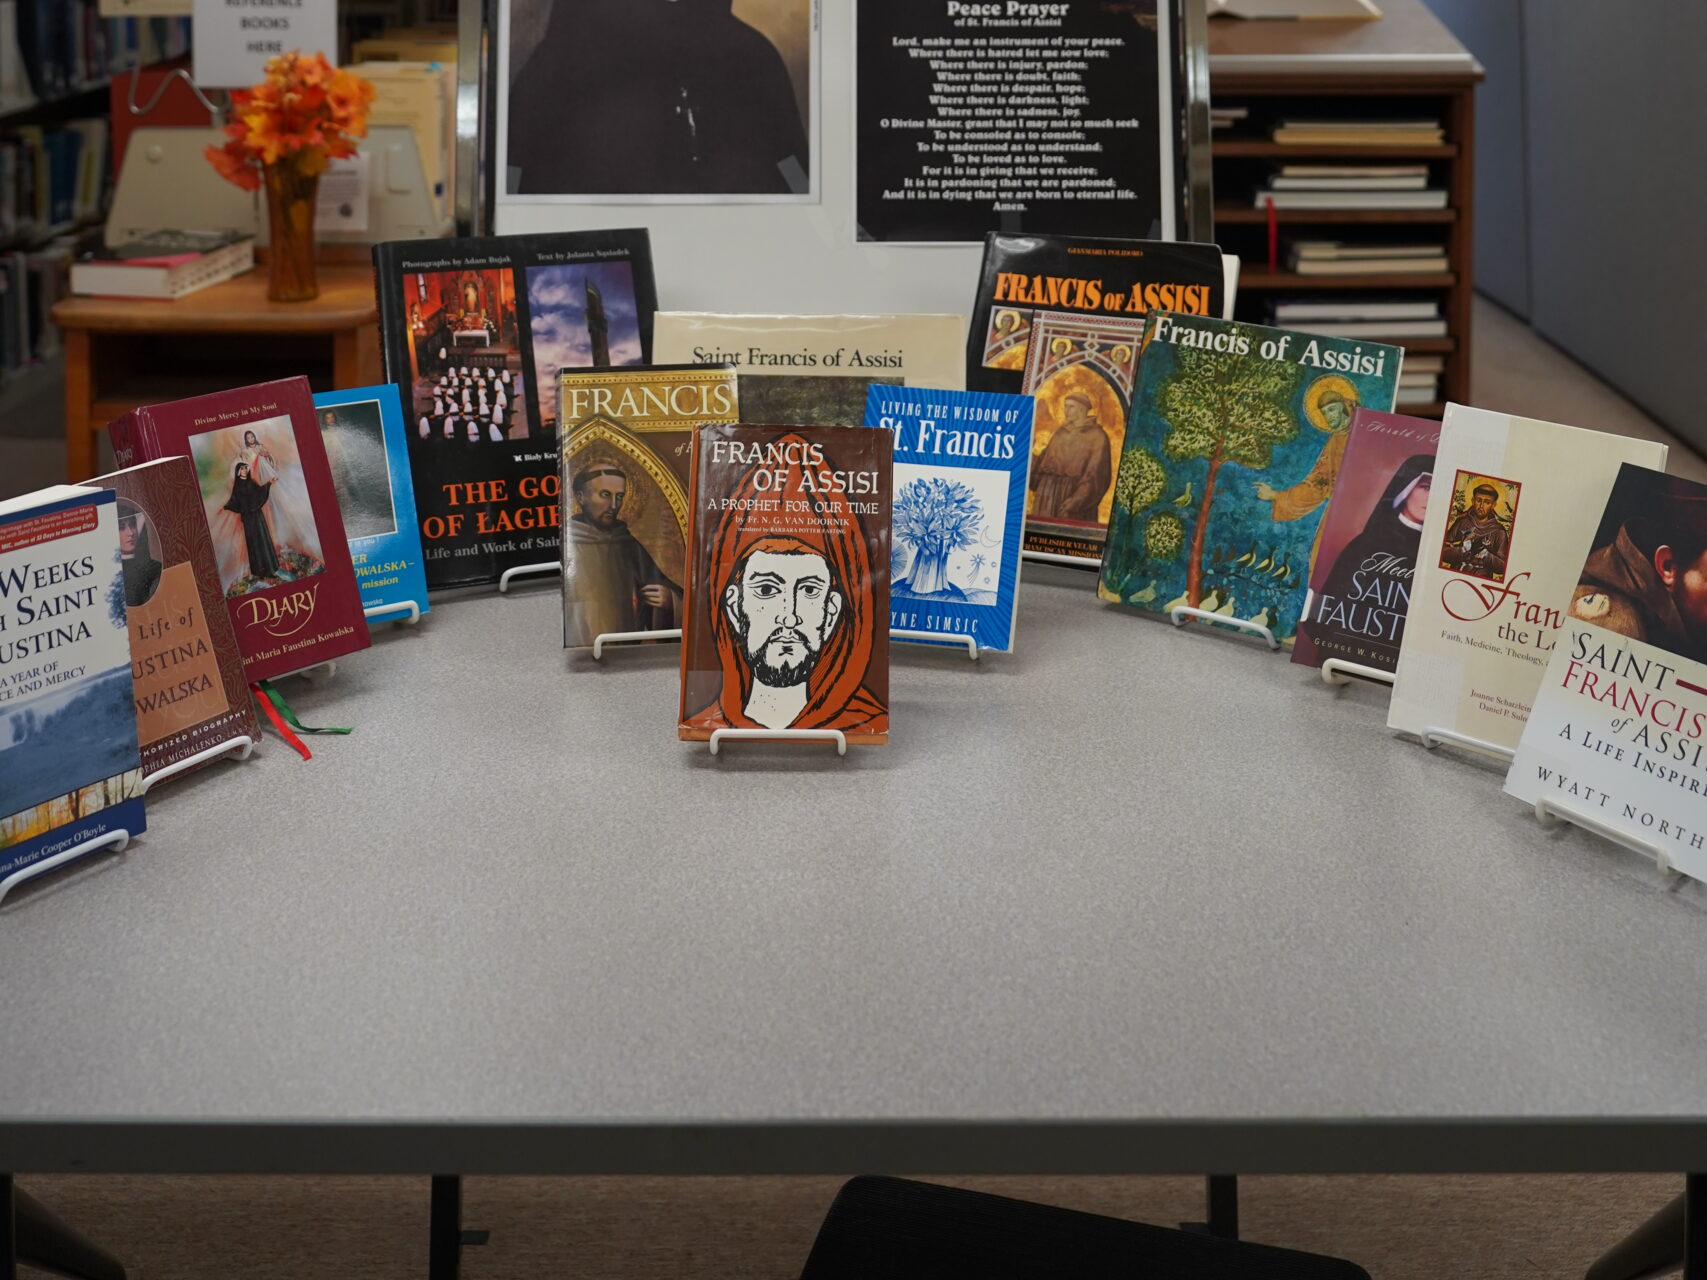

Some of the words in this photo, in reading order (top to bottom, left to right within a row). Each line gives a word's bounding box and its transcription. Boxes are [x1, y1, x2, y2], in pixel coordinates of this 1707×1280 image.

[948, 1, 1001, 16] Peace
[1007, 1, 1069, 18] Prayer
[954, 18, 965, 26] of
[982, 18, 1019, 26] Francis
[1021, 18, 1032, 26] of
[1034, 16, 1061, 26] Assisi
[240, 18, 290, 30] BOOKS
[246, 40, 283, 53] HERE
[922, 37, 952, 46] make
[990, 37, 1048, 46] instrument
[1051, 36, 1062, 45] of
[1064, 38, 1089, 46] your
[1092, 38, 1124, 47] peace.
[883, 190, 904, 199] And
[907, 190, 915, 198] it
[918, 190, 926, 198] is
[929, 190, 940, 198] in
[942, 190, 972, 200] dying
[974, 190, 996, 198] that
[1036, 190, 1061, 198] born
[1076, 190, 1114, 198] eternal
[1117, 190, 1136, 198] life.
[402, 260, 451, 269] Photographs
[452, 258, 462, 266] by
[464, 257, 487, 265] Adam
[489, 256, 512, 264] Bujak
[536, 253, 554, 261] Text
[556, 252, 565, 260] by
[993, 273, 1102, 310] FRANCIS
[1125, 282, 1211, 316] ASSISI
[692, 347, 741, 366] Saint
[747, 347, 817, 367] Francis
[822, 347, 845, 367] of
[848, 349, 903, 368] Assisi
[1152, 316, 1250, 356] Francis
[1260, 335, 1291, 362] of
[1298, 339, 1385, 377] Assisi
[569, 384, 732, 419] FRANCIS
[881, 400, 921, 416] LIVING
[927, 404, 948, 419] THE
[954, 406, 1000, 422] WISDOM
[1006, 410, 1019, 423] OF
[194, 415, 217, 426] Divine
[218, 410, 240, 422] Mercy
[241, 408, 248, 416] in
[250, 406, 261, 416] My
[262, 402, 278, 412] Soul
[674, 443, 686, 456] of
[879, 417, 909, 451] St.
[915, 420, 1016, 459] Francis
[712, 441, 824, 466] FRANCIS
[443, 479, 509, 506] THE
[753, 469, 790, 492] OF
[798, 470, 879, 494] ASSISI
[708, 498, 718, 510] A
[721, 498, 781, 512] PROPHET
[785, 500, 810, 513] FOR
[814, 500, 842, 514] OUR
[846, 502, 879, 514] TIME
[423, 513, 465, 539] OF
[736, 516, 744, 524] by
[748, 516, 760, 524] Fr.
[762, 516, 770, 524] N.
[785, 517, 804, 525] VAN
[807, 518, 850, 526] DOORNIK
[425, 547, 451, 560] Life
[454, 545, 479, 557] and
[482, 540, 516, 554] Work
[520, 538, 534, 550] of
[361, 576, 398, 589] mission
[16, 585, 98, 626] SAINT
[139, 617, 171, 641] Life
[179, 606, 194, 628] of
[927, 616, 978, 633] SIMSIC
[1497, 622, 1529, 645] the
[256, 648, 281, 662] Maria
[282, 637, 316, 655] Faustina
[318, 625, 354, 644] Kowalska
[1314, 637, 1352, 653] GEORGE
[1357, 646, 1368, 658] W.
[1441, 630, 1464, 644] Faith,
[1465, 636, 1503, 654] Medicine,
[1505, 647, 1544, 667] Theology,
[10, 666, 40, 685] YEAR
[43, 662, 59, 673] OF
[1571, 631, 1675, 692] SAINT
[16, 679, 44, 697] AND
[46, 664, 86, 687] MERCY
[1470, 689, 1494, 702] Joanne
[1561, 659, 1707, 740] FRANCIS
[143, 734, 188, 757] HORIZED
[192, 709, 247, 737] BIOGRAPHY
[1558, 723, 1572, 741] A
[1581, 731, 1626, 762] LIFE
[1611, 716, 1633, 734] of
[1632, 723, 1707, 772] ASSI
[1536, 766, 1611, 808] WYATT
[1621, 803, 1704, 850] NORTH
[41, 838, 72, 860] Cooper
[74, 822, 107, 844] O'Boyle
